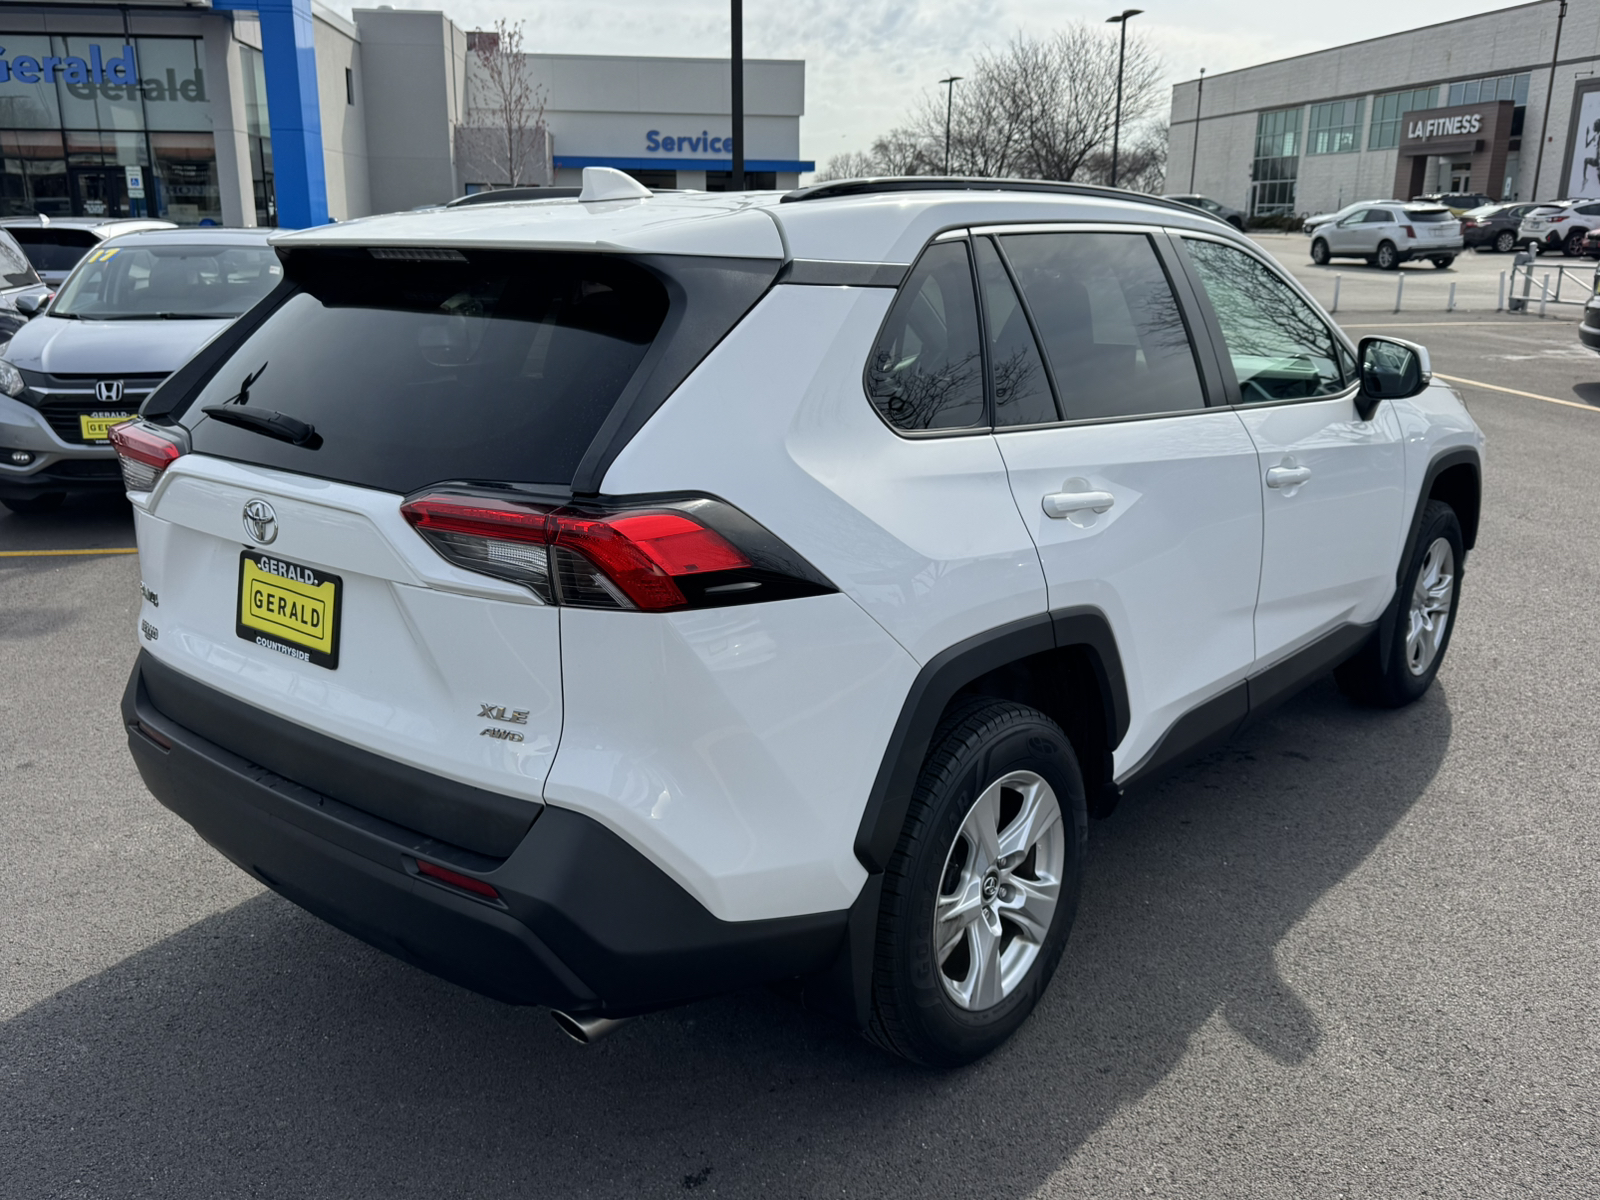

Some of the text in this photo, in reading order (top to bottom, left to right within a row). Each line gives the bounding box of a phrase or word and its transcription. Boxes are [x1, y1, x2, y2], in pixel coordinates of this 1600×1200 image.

[1408, 113, 1482, 139] LA FITNESS
[646, 130, 733, 153] Service
[88, 248, 122, 264] 17
[260, 556, 315, 585] GERALD
[254, 589, 320, 628] GERALD
[256, 636, 310, 662] COUNTRYSIDE
[477, 703, 530, 725] XLE
[479, 727, 524, 743] AWD
